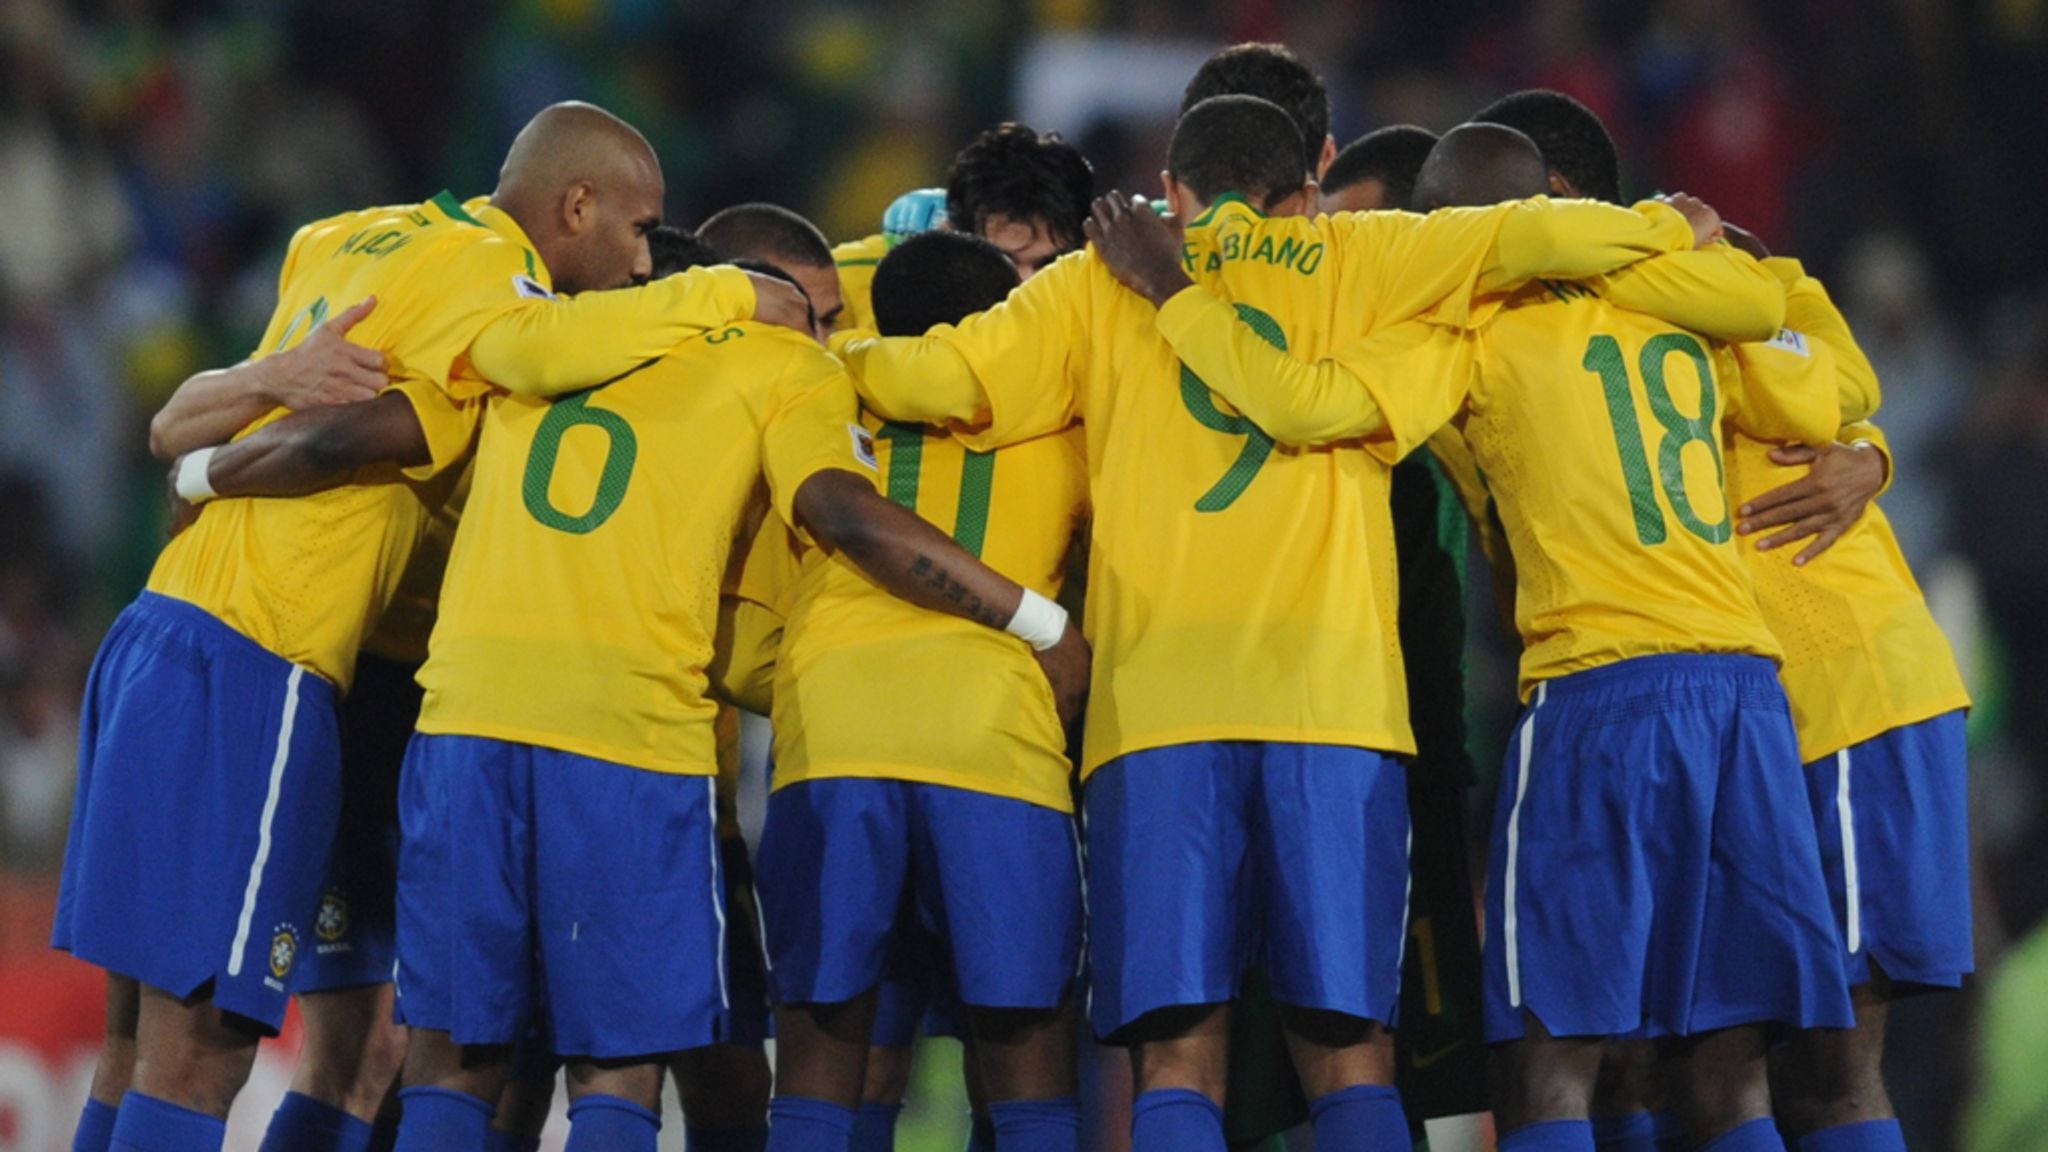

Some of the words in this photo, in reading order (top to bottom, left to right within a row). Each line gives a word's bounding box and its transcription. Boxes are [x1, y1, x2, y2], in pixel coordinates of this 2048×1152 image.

[1183, 233, 1325, 276] FABIANO
[522, 390, 638, 535] 6
[1180, 303, 1288, 513] 9
[1582, 333, 1732, 546] 18
[876, 421, 997, 560] 11
